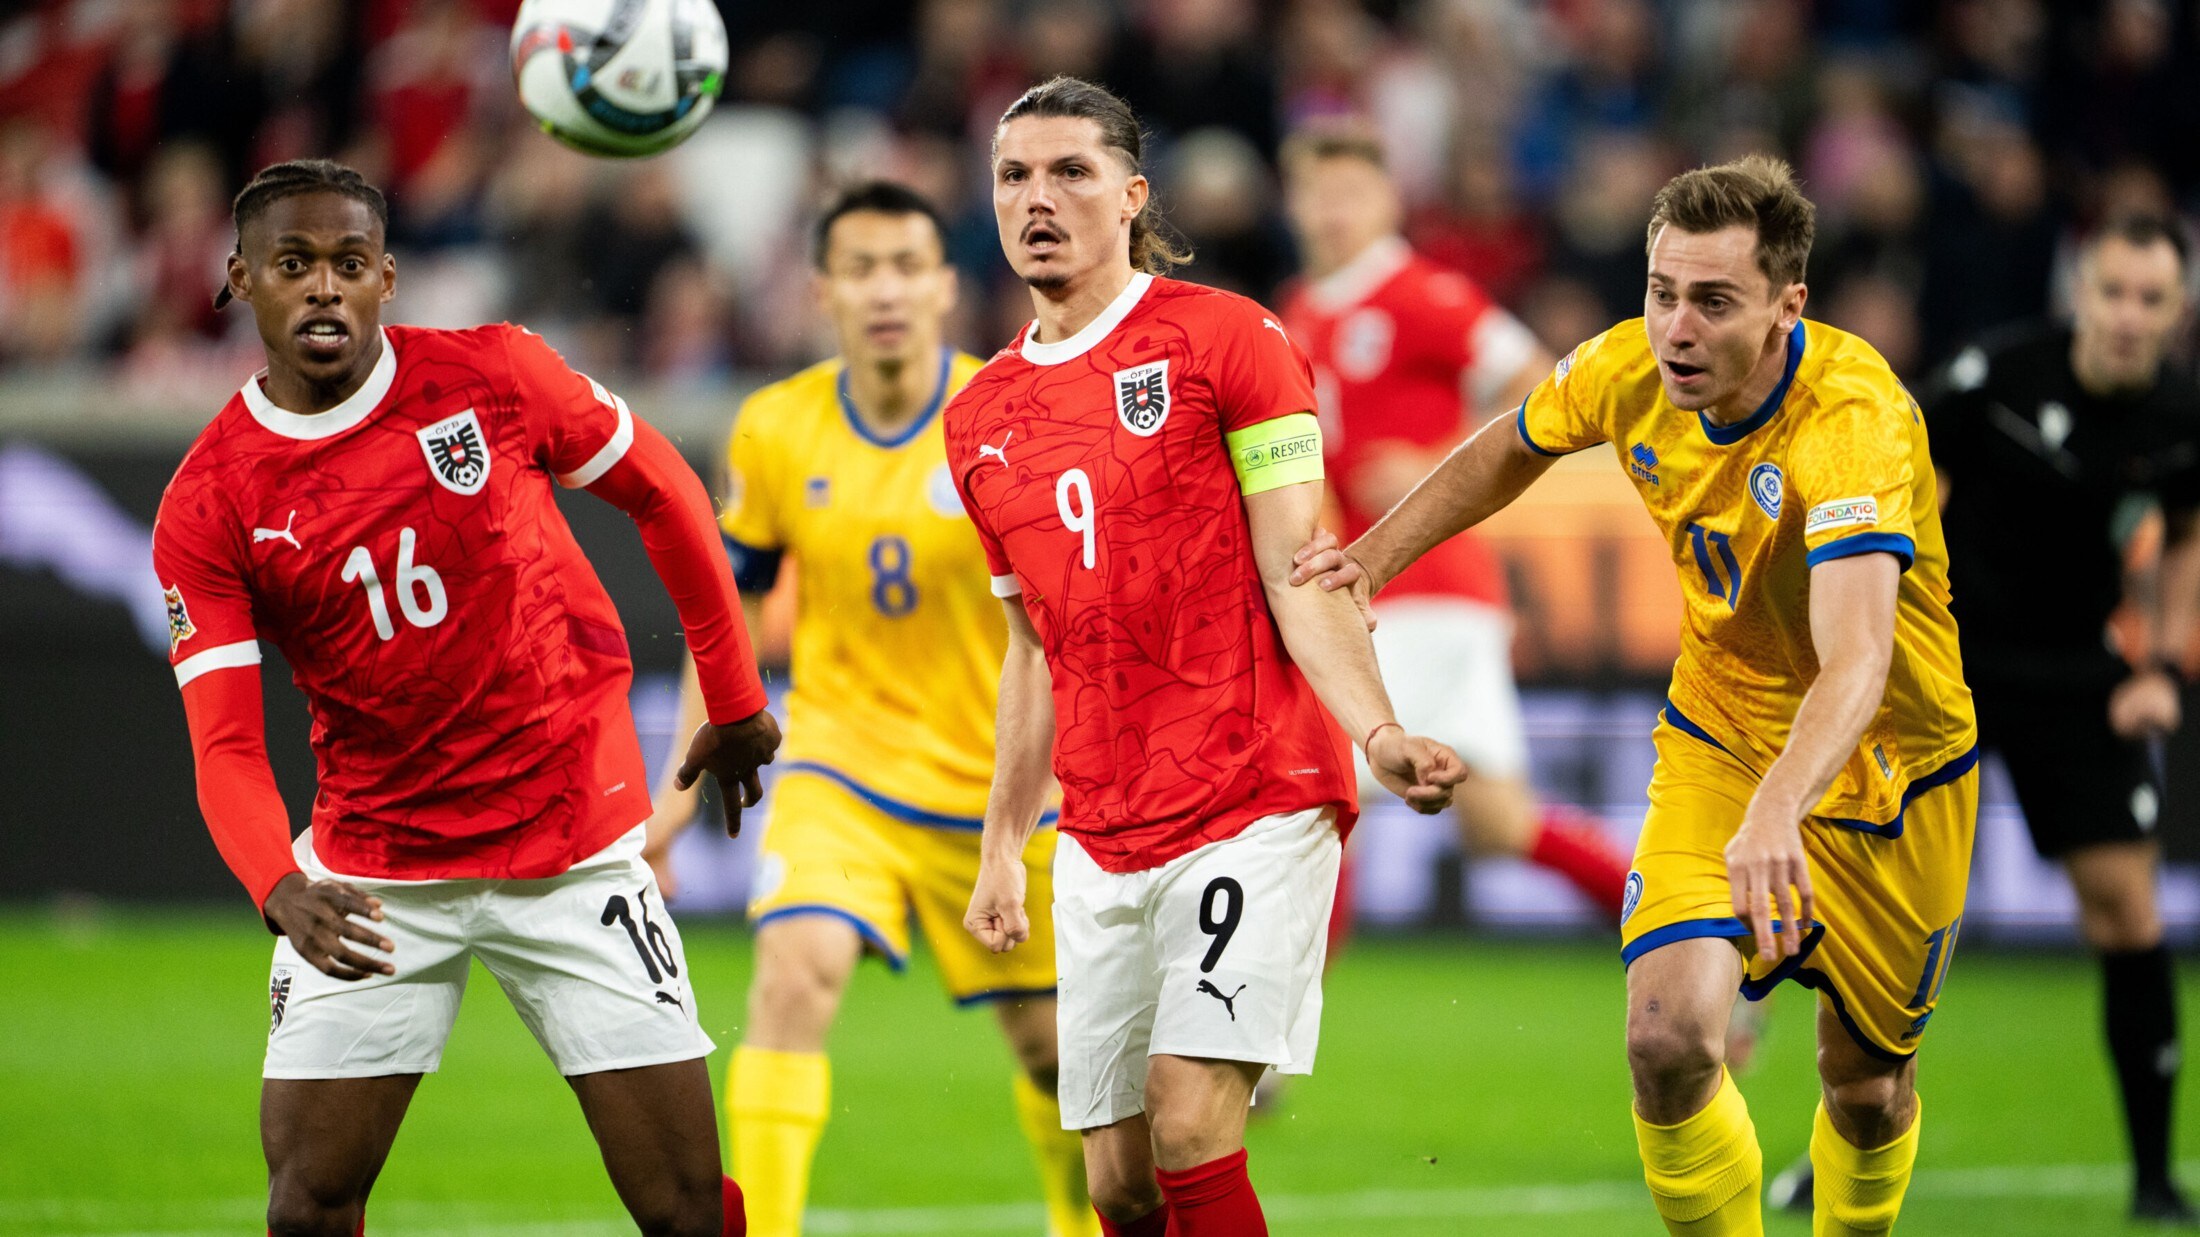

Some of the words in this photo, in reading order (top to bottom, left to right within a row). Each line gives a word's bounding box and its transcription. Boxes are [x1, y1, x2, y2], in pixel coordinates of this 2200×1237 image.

[1271, 439, 1317, 460] RESPECT
[1056, 468, 1095, 569] 9
[1685, 521, 1742, 612] 11
[341, 527, 448, 641] 16
[867, 534, 918, 618] 8
[601, 886, 678, 984] 16
[1199, 876, 1244, 973] 9
[1905, 914, 1961, 1009] 11
